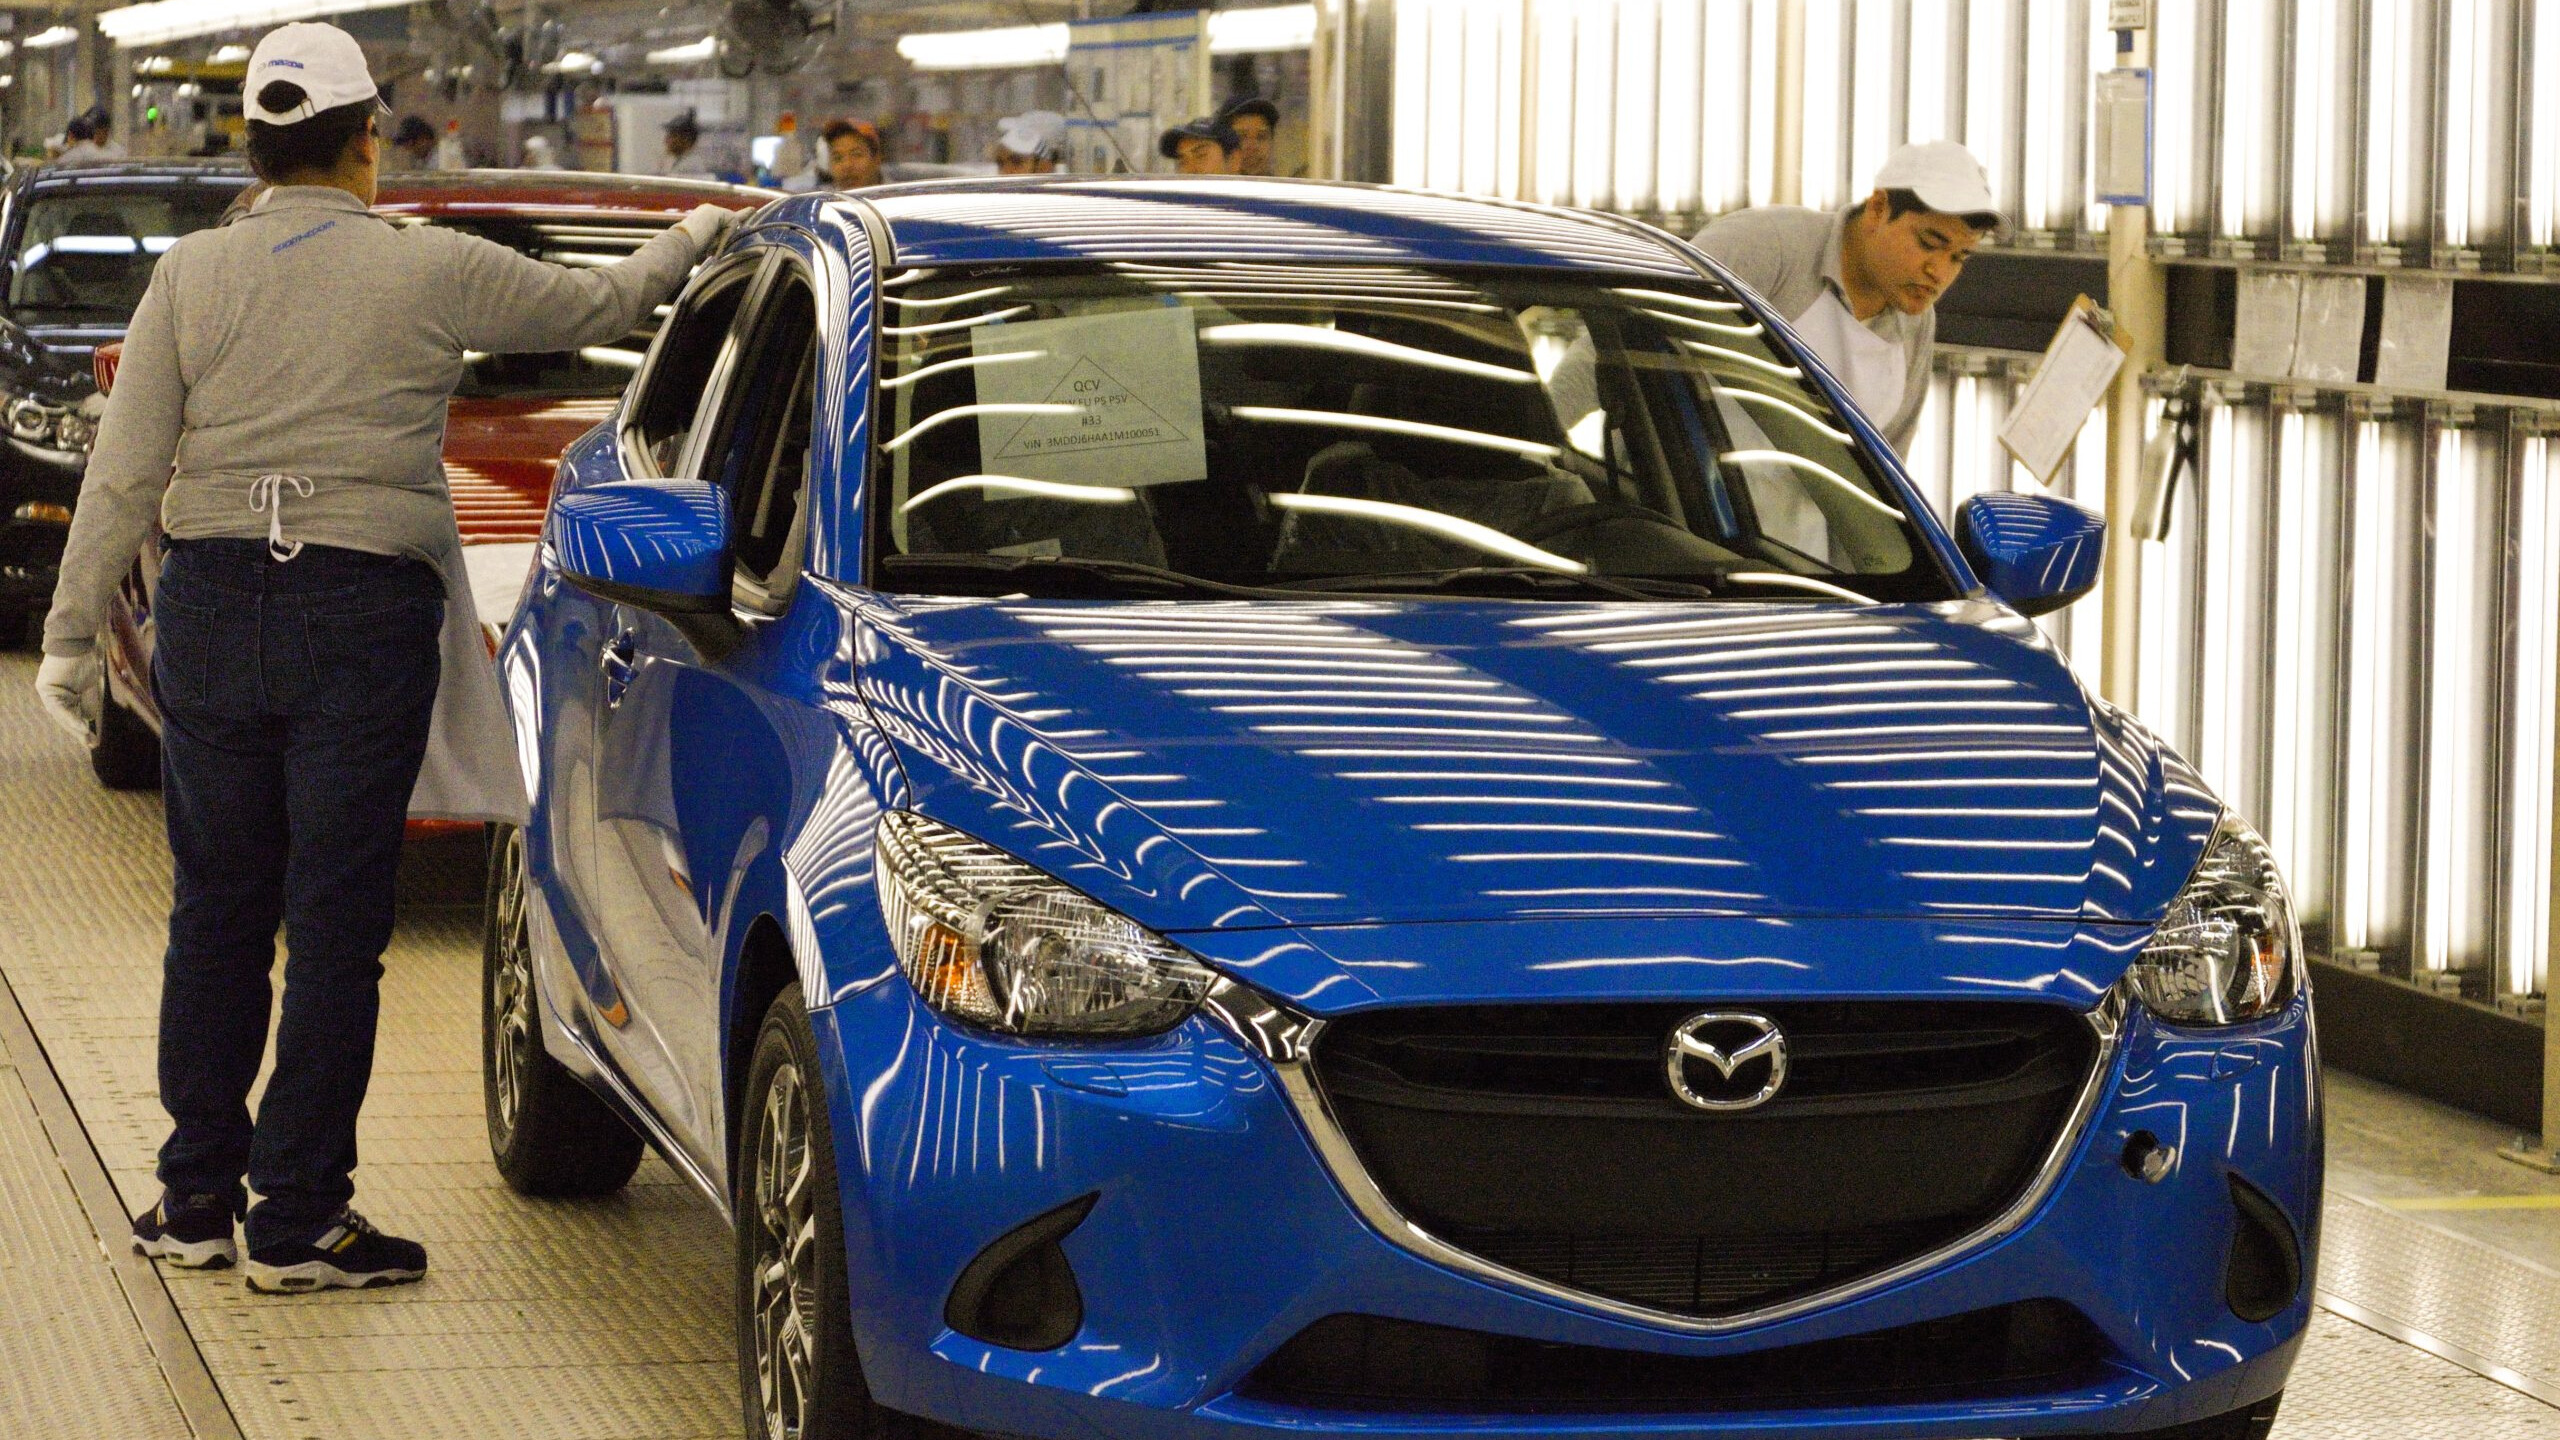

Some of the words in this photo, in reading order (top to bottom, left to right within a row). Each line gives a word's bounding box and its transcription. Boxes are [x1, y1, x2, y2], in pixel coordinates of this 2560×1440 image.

[268, 59, 304, 69] mazda
[1073, 379, 1101, 393] QCV
[1081, 415, 1102, 427] #33
[1023, 439, 1041, 451] VIN
